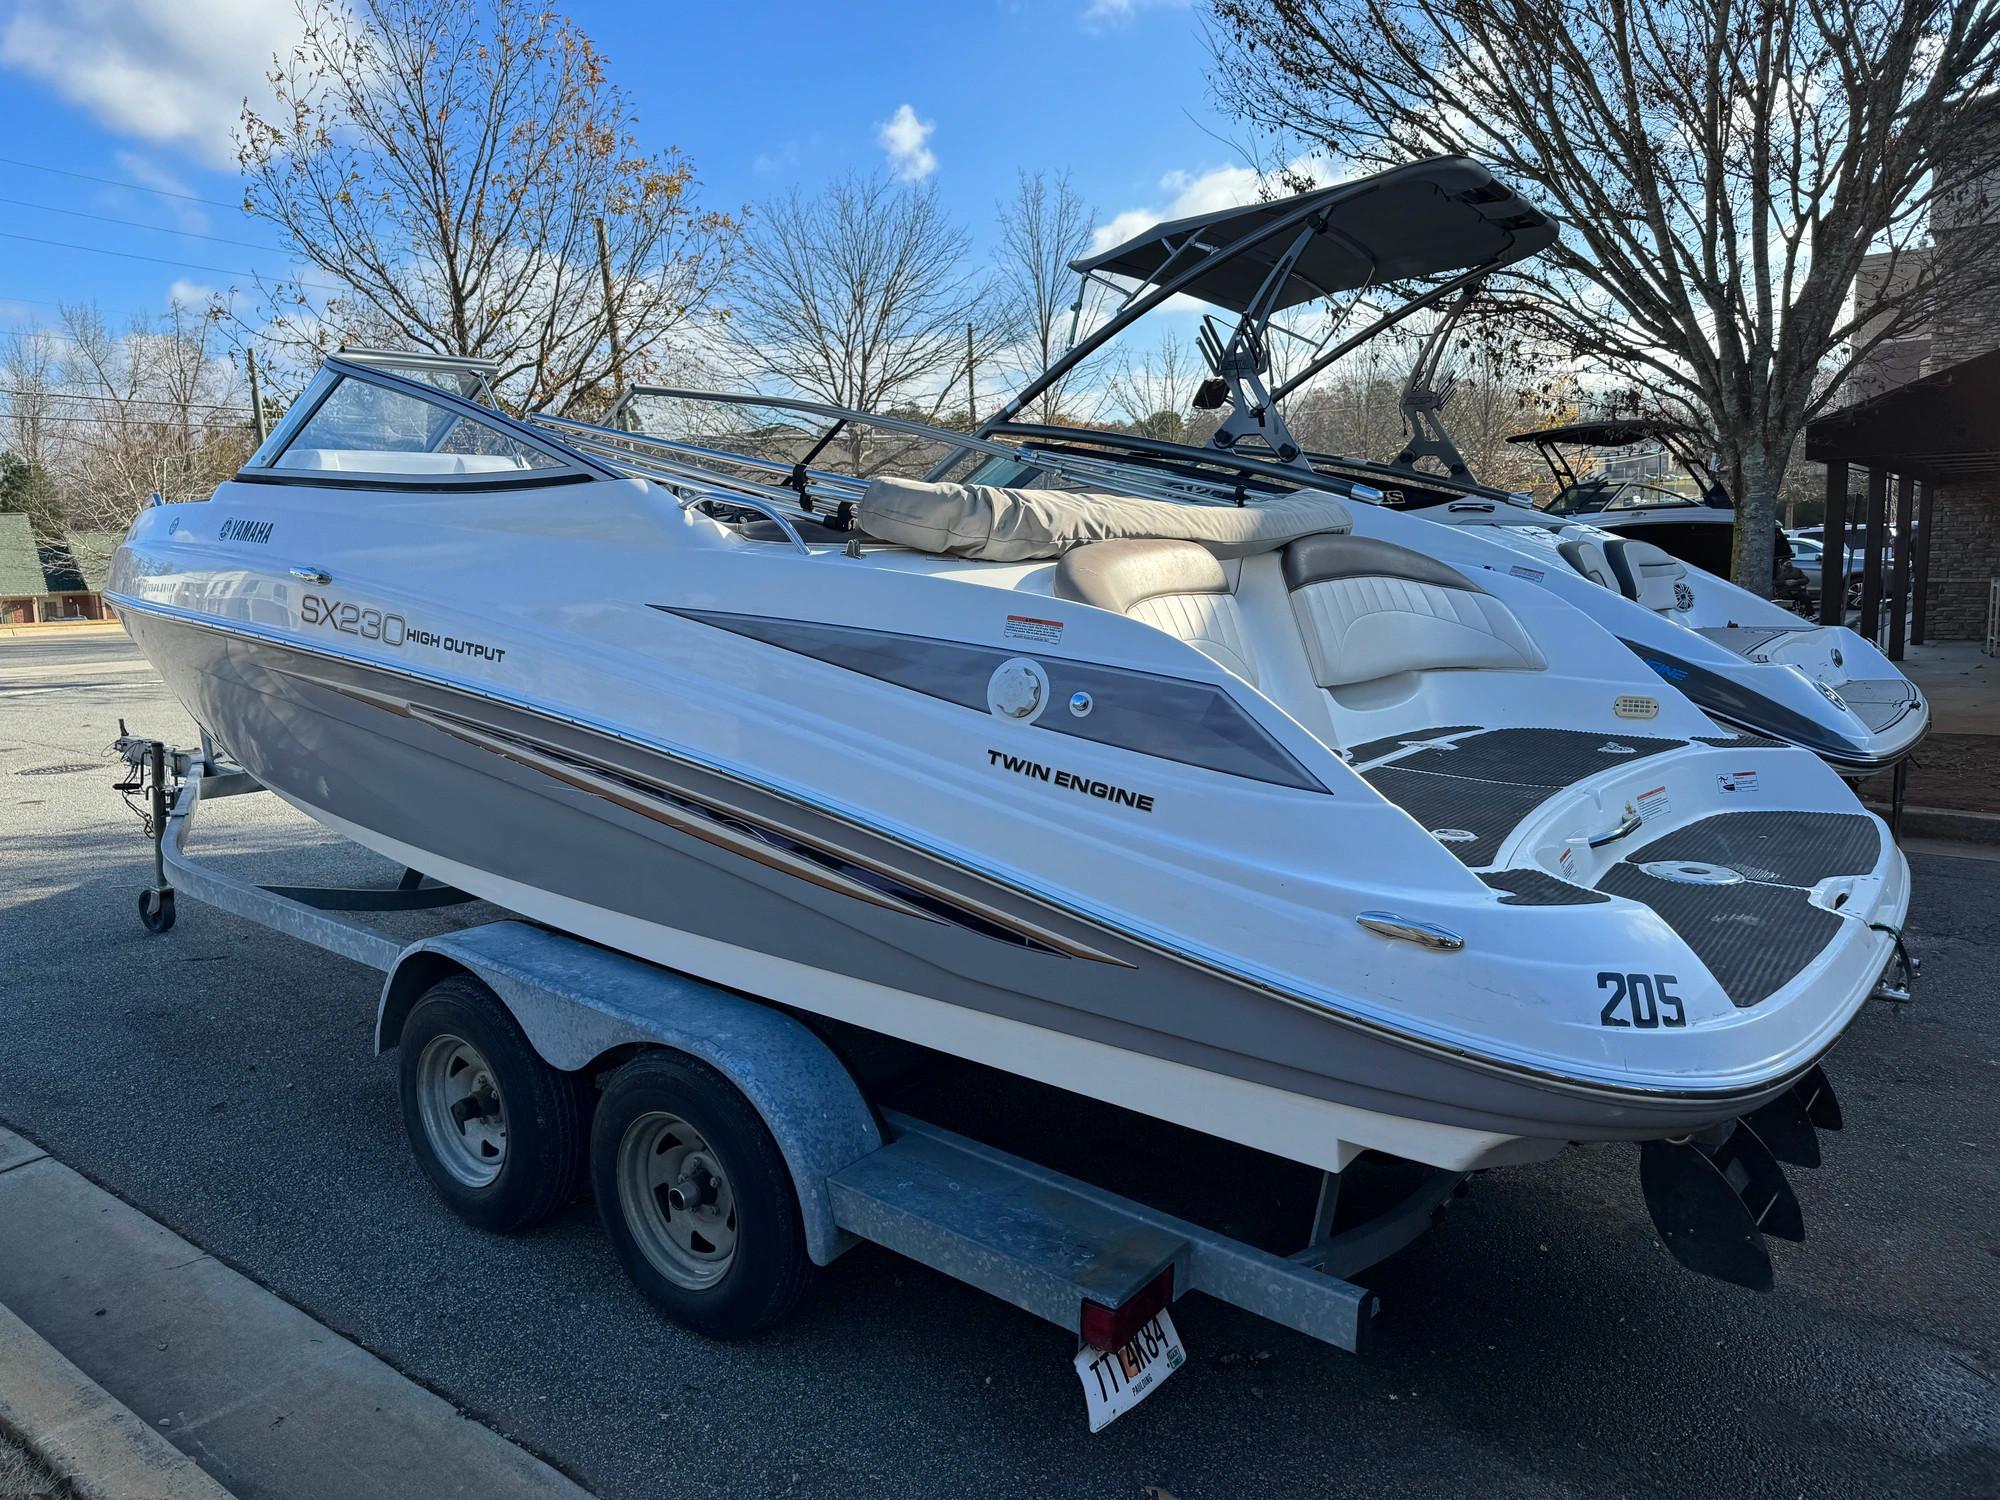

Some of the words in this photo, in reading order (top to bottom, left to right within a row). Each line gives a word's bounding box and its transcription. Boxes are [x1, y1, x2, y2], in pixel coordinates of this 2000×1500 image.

[229, 519, 274, 544] YAMAHA
[301, 594, 405, 646] SX230
[406, 628, 440, 648] HIGH
[443, 637, 505, 663] OUTPUT
[988, 749, 1051, 782] TWIN
[1054, 770, 1154, 812] ENGINE
[1596, 971, 1687, 1028] 205
